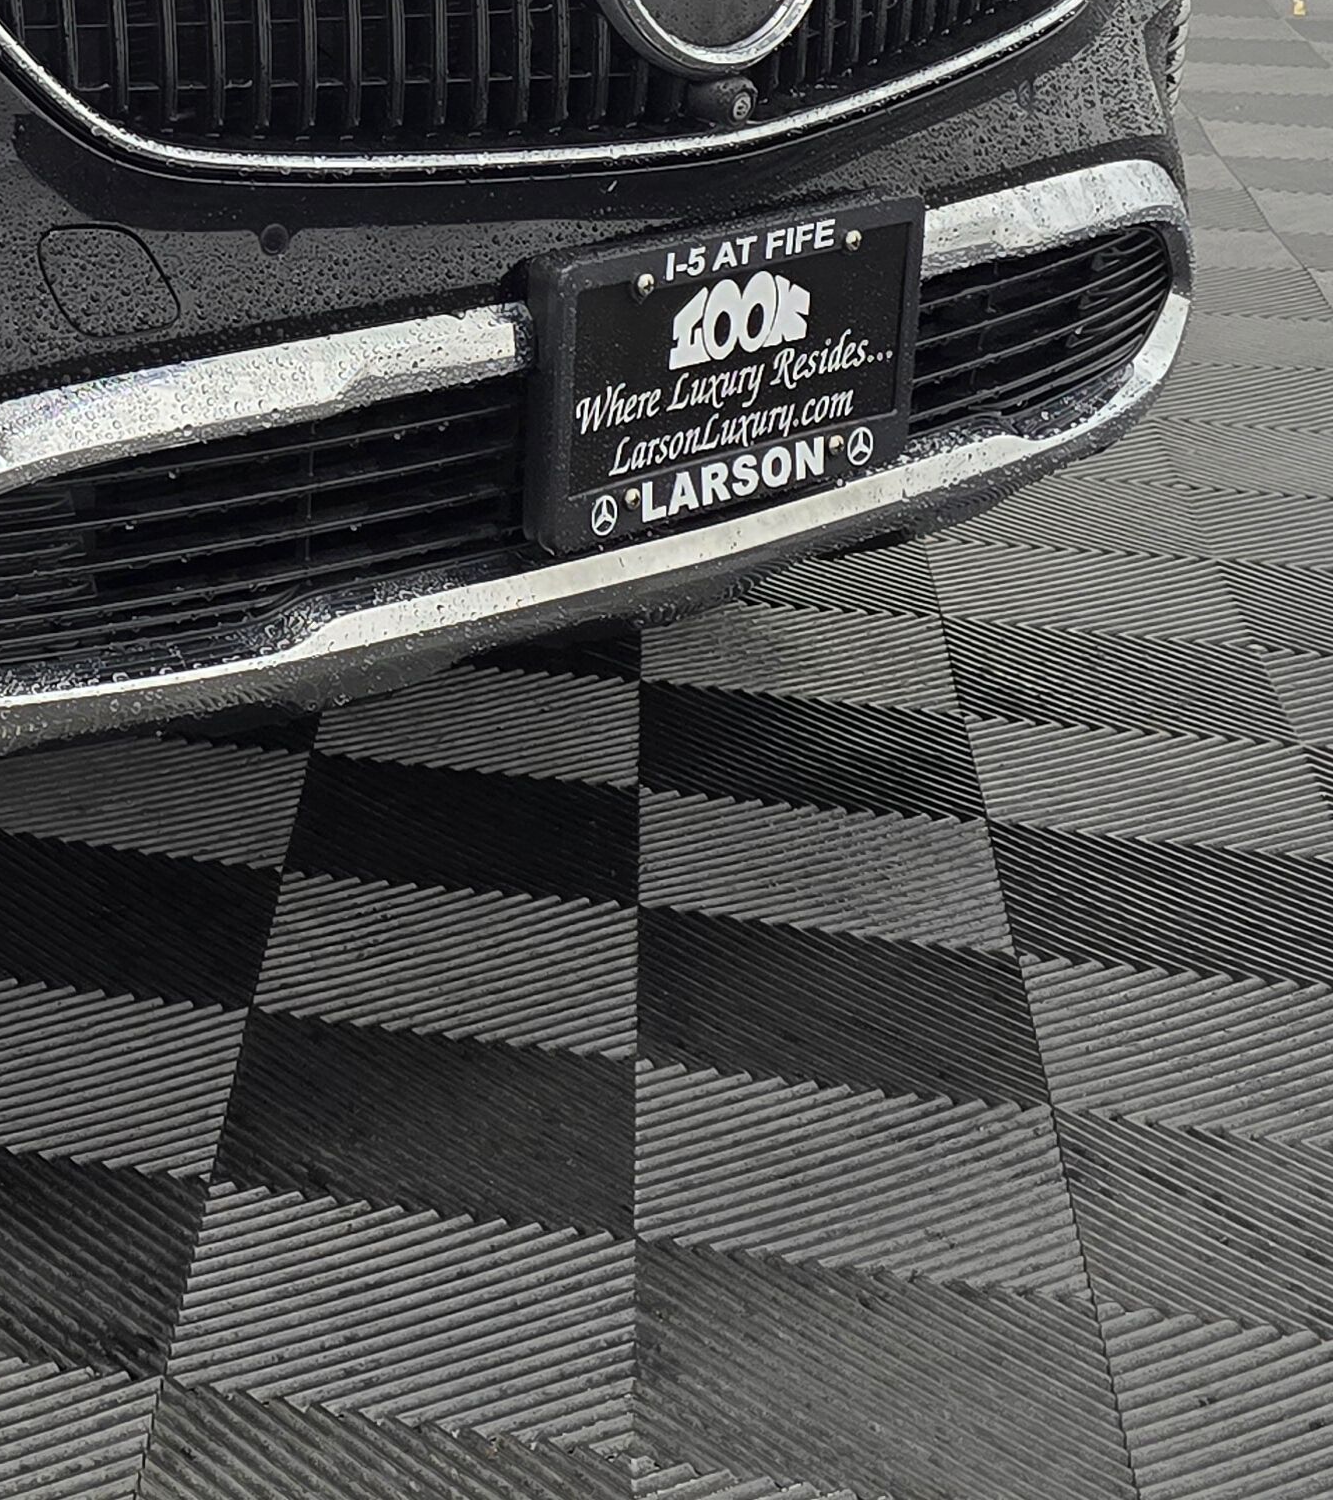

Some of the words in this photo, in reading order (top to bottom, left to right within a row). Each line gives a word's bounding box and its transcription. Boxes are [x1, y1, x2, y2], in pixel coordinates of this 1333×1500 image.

[665, 246, 706, 281] I-5
[712, 236, 757, 272] AT
[765, 219, 836, 259] FIFE
[669, 270, 811, 370] LOOK
[576, 384, 660, 434] Where
[666, 359, 766, 413] Luxury
[770, 328, 893, 386] Resides...
[608, 388, 854, 477] LarsonLuxury.com
[640, 436, 825, 522] LARSON
